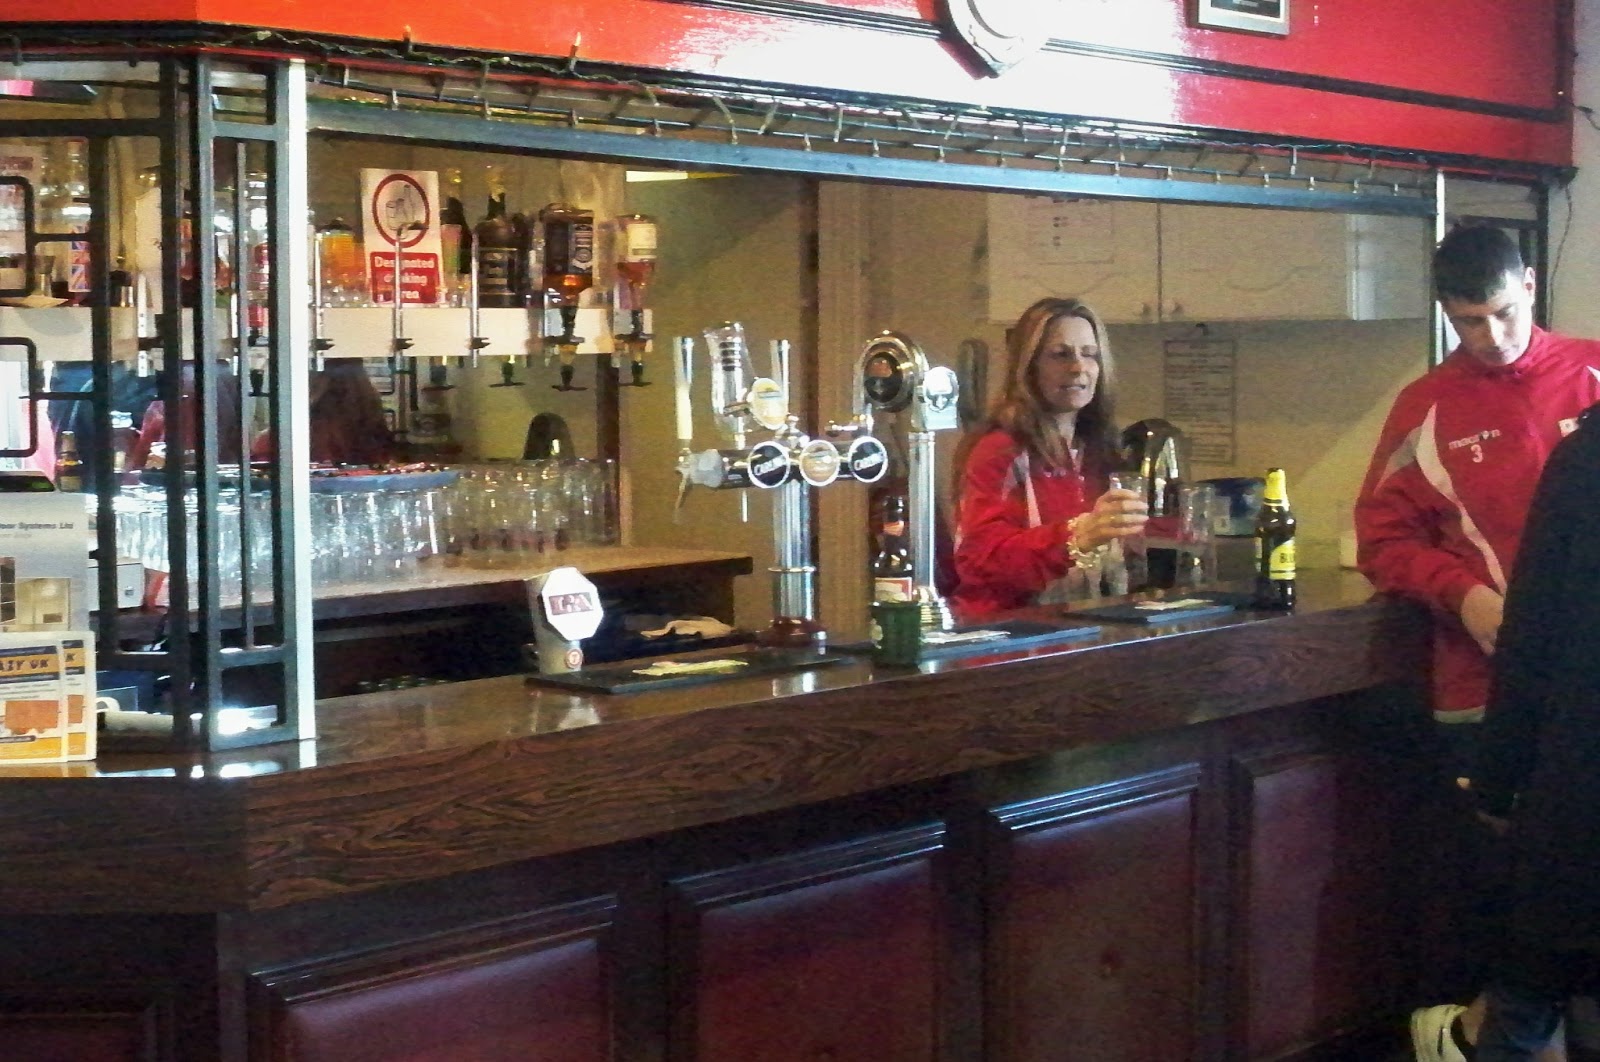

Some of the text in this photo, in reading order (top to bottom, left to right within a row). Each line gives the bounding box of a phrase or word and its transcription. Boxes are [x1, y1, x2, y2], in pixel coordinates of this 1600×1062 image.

[374, 256, 435, 270] Desgnated
[396, 290, 420, 299] rea
[1470, 444, 1483, 463] 3
[59, 522, 74, 530] Ltd
